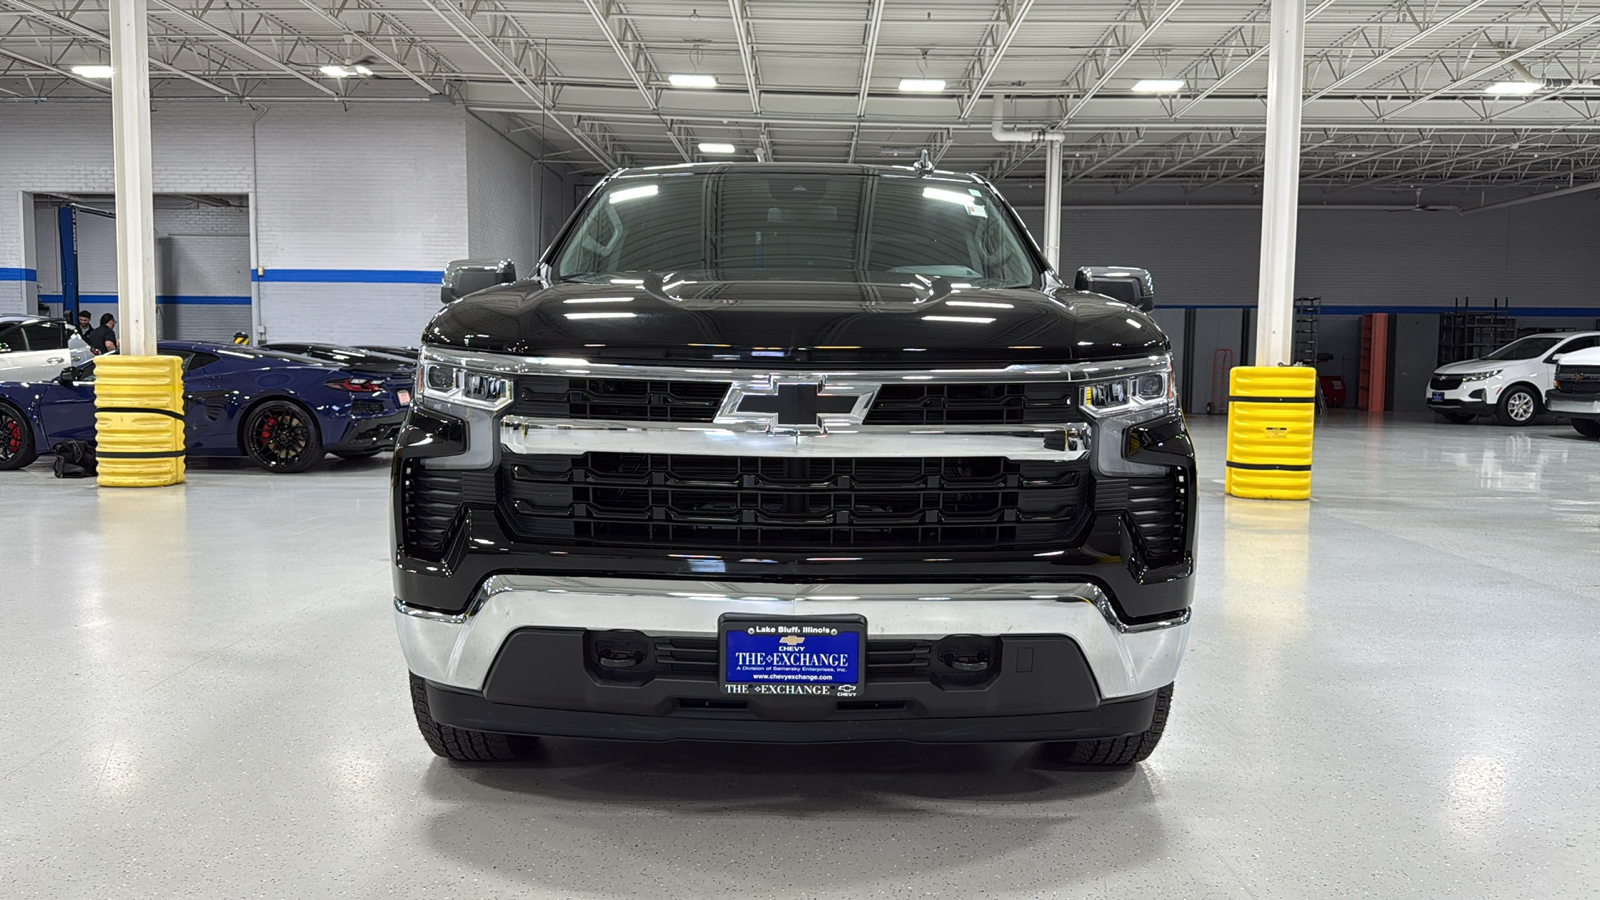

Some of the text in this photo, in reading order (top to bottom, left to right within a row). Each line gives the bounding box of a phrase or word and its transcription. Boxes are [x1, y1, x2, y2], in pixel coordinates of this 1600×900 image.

[735, 652, 848, 666] THE EXCHANGE
[725, 684, 830, 694] THE EXCHANGE
